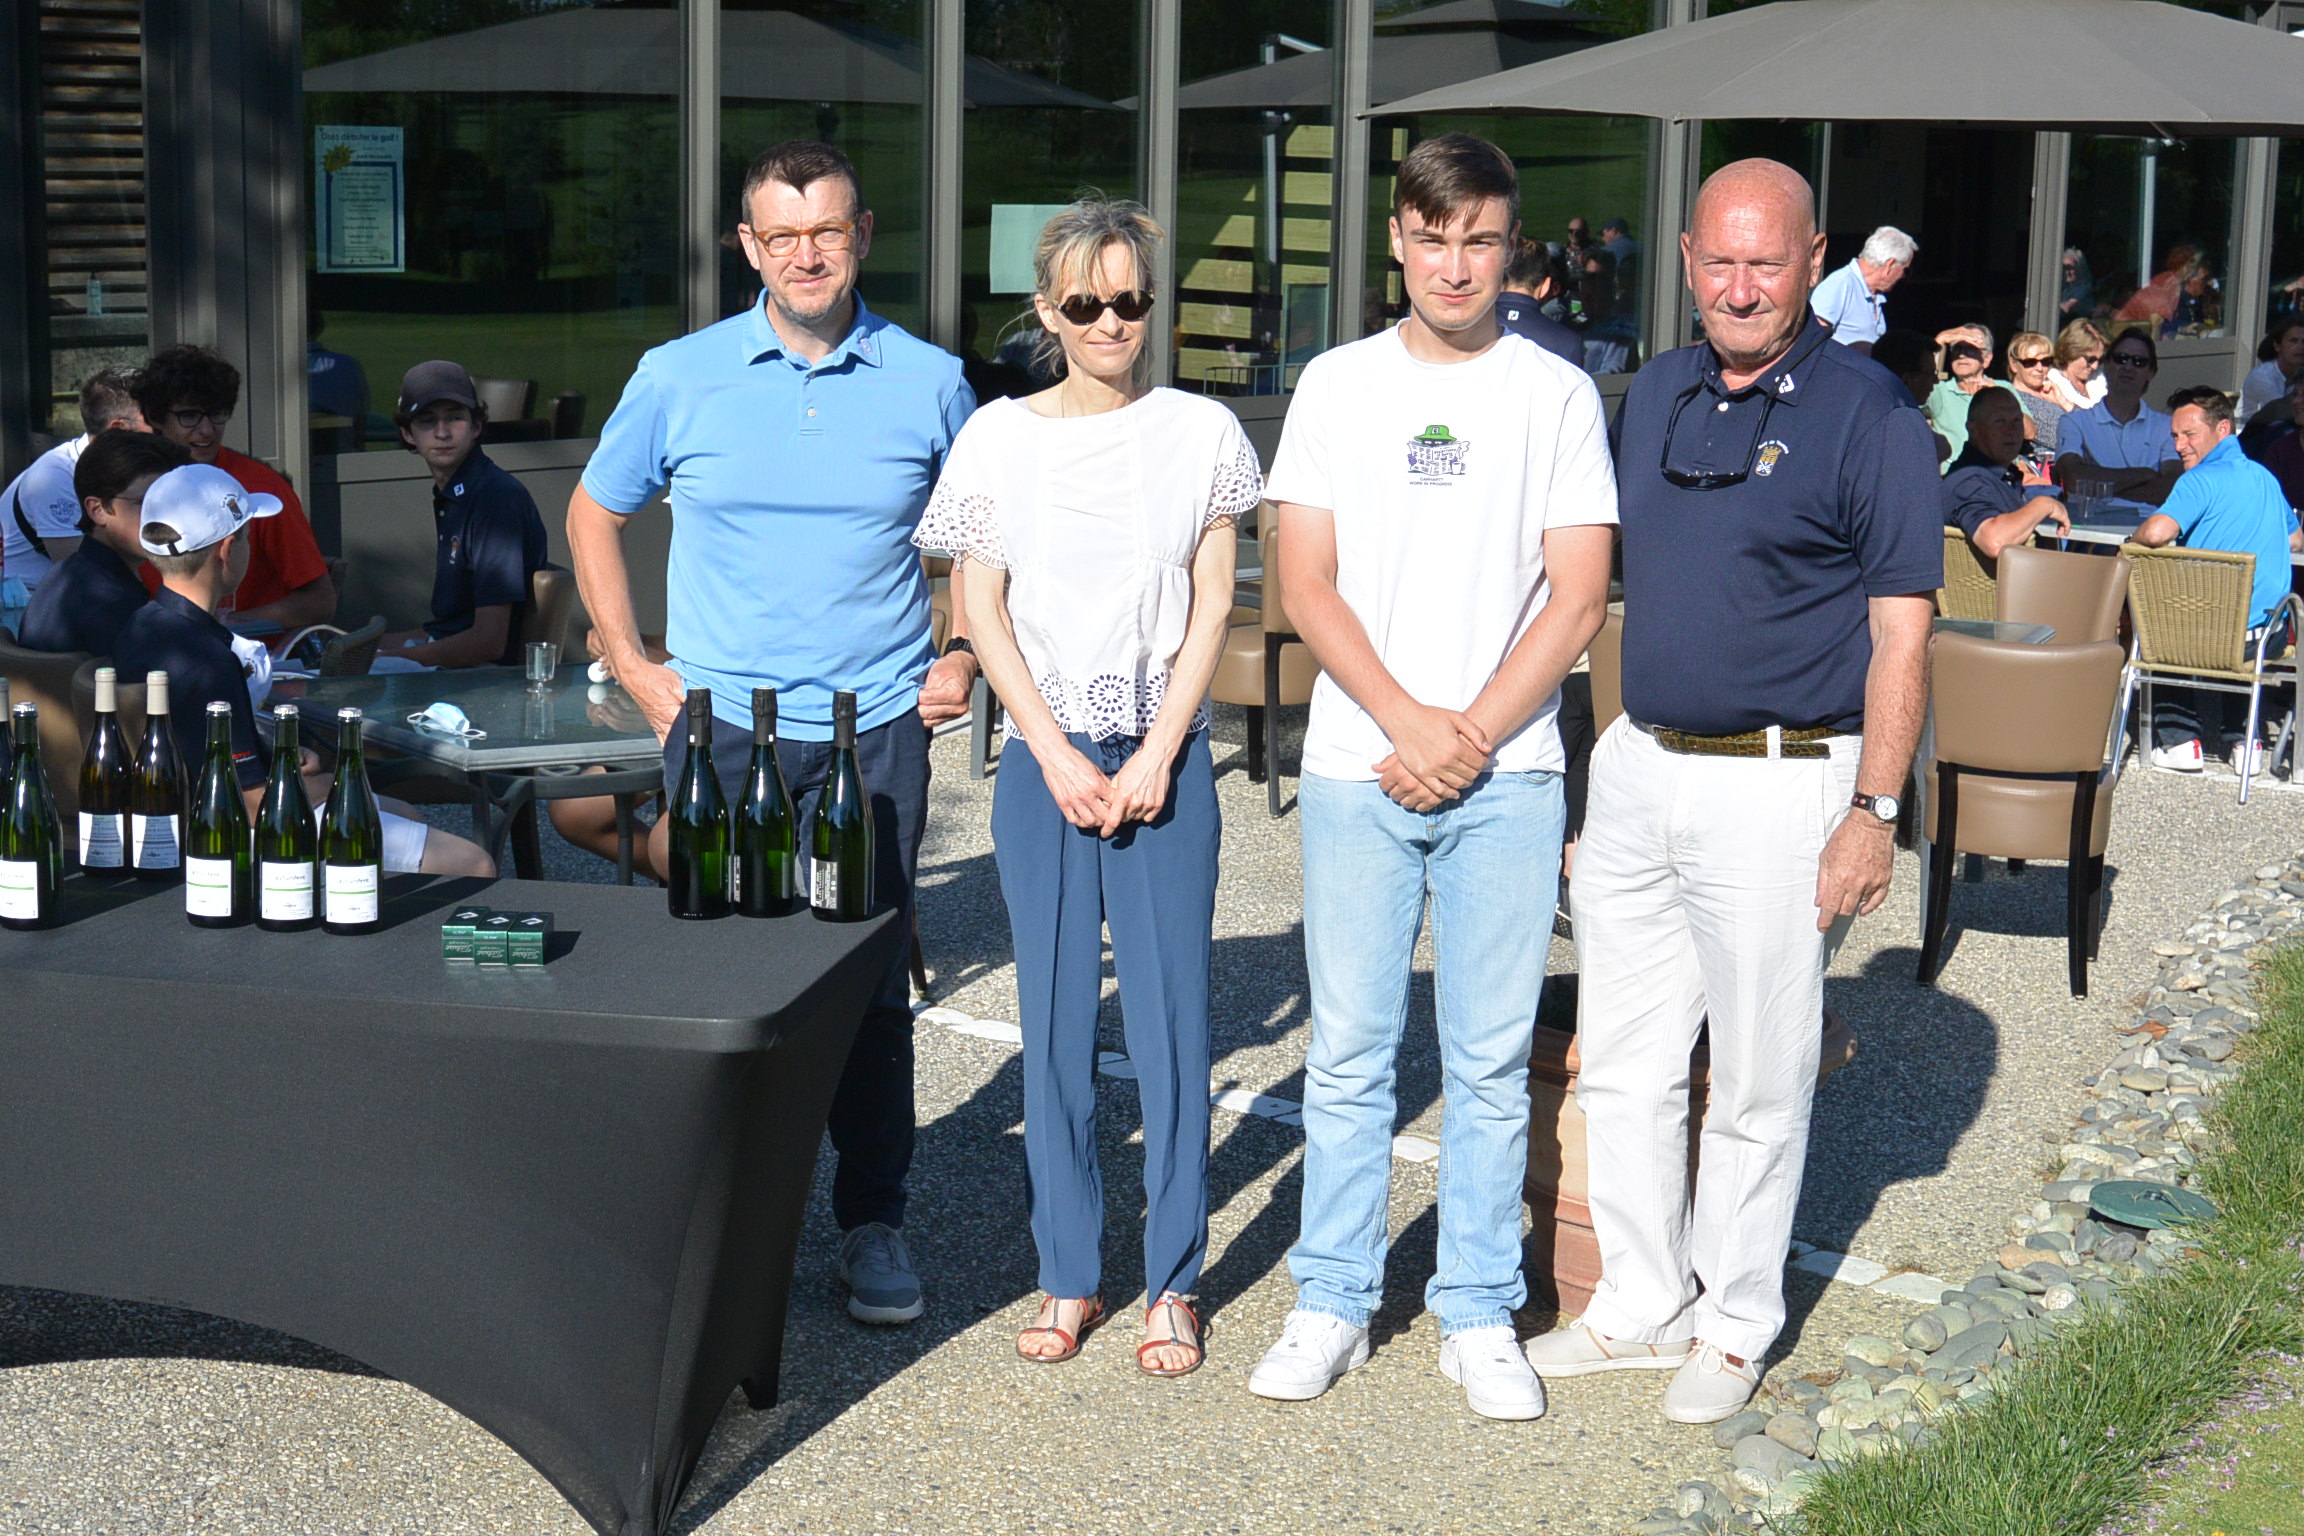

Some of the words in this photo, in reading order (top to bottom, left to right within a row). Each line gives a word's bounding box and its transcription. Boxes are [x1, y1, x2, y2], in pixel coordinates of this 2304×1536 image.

[341, 132, 370, 140] débuter
[371, 132, 379, 140] le
[380, 133, 394, 143] golf
[444, 944, 474, 953] Titleist
[476, 949, 505, 958] Titleist
[512, 950, 540, 960] Titleist
